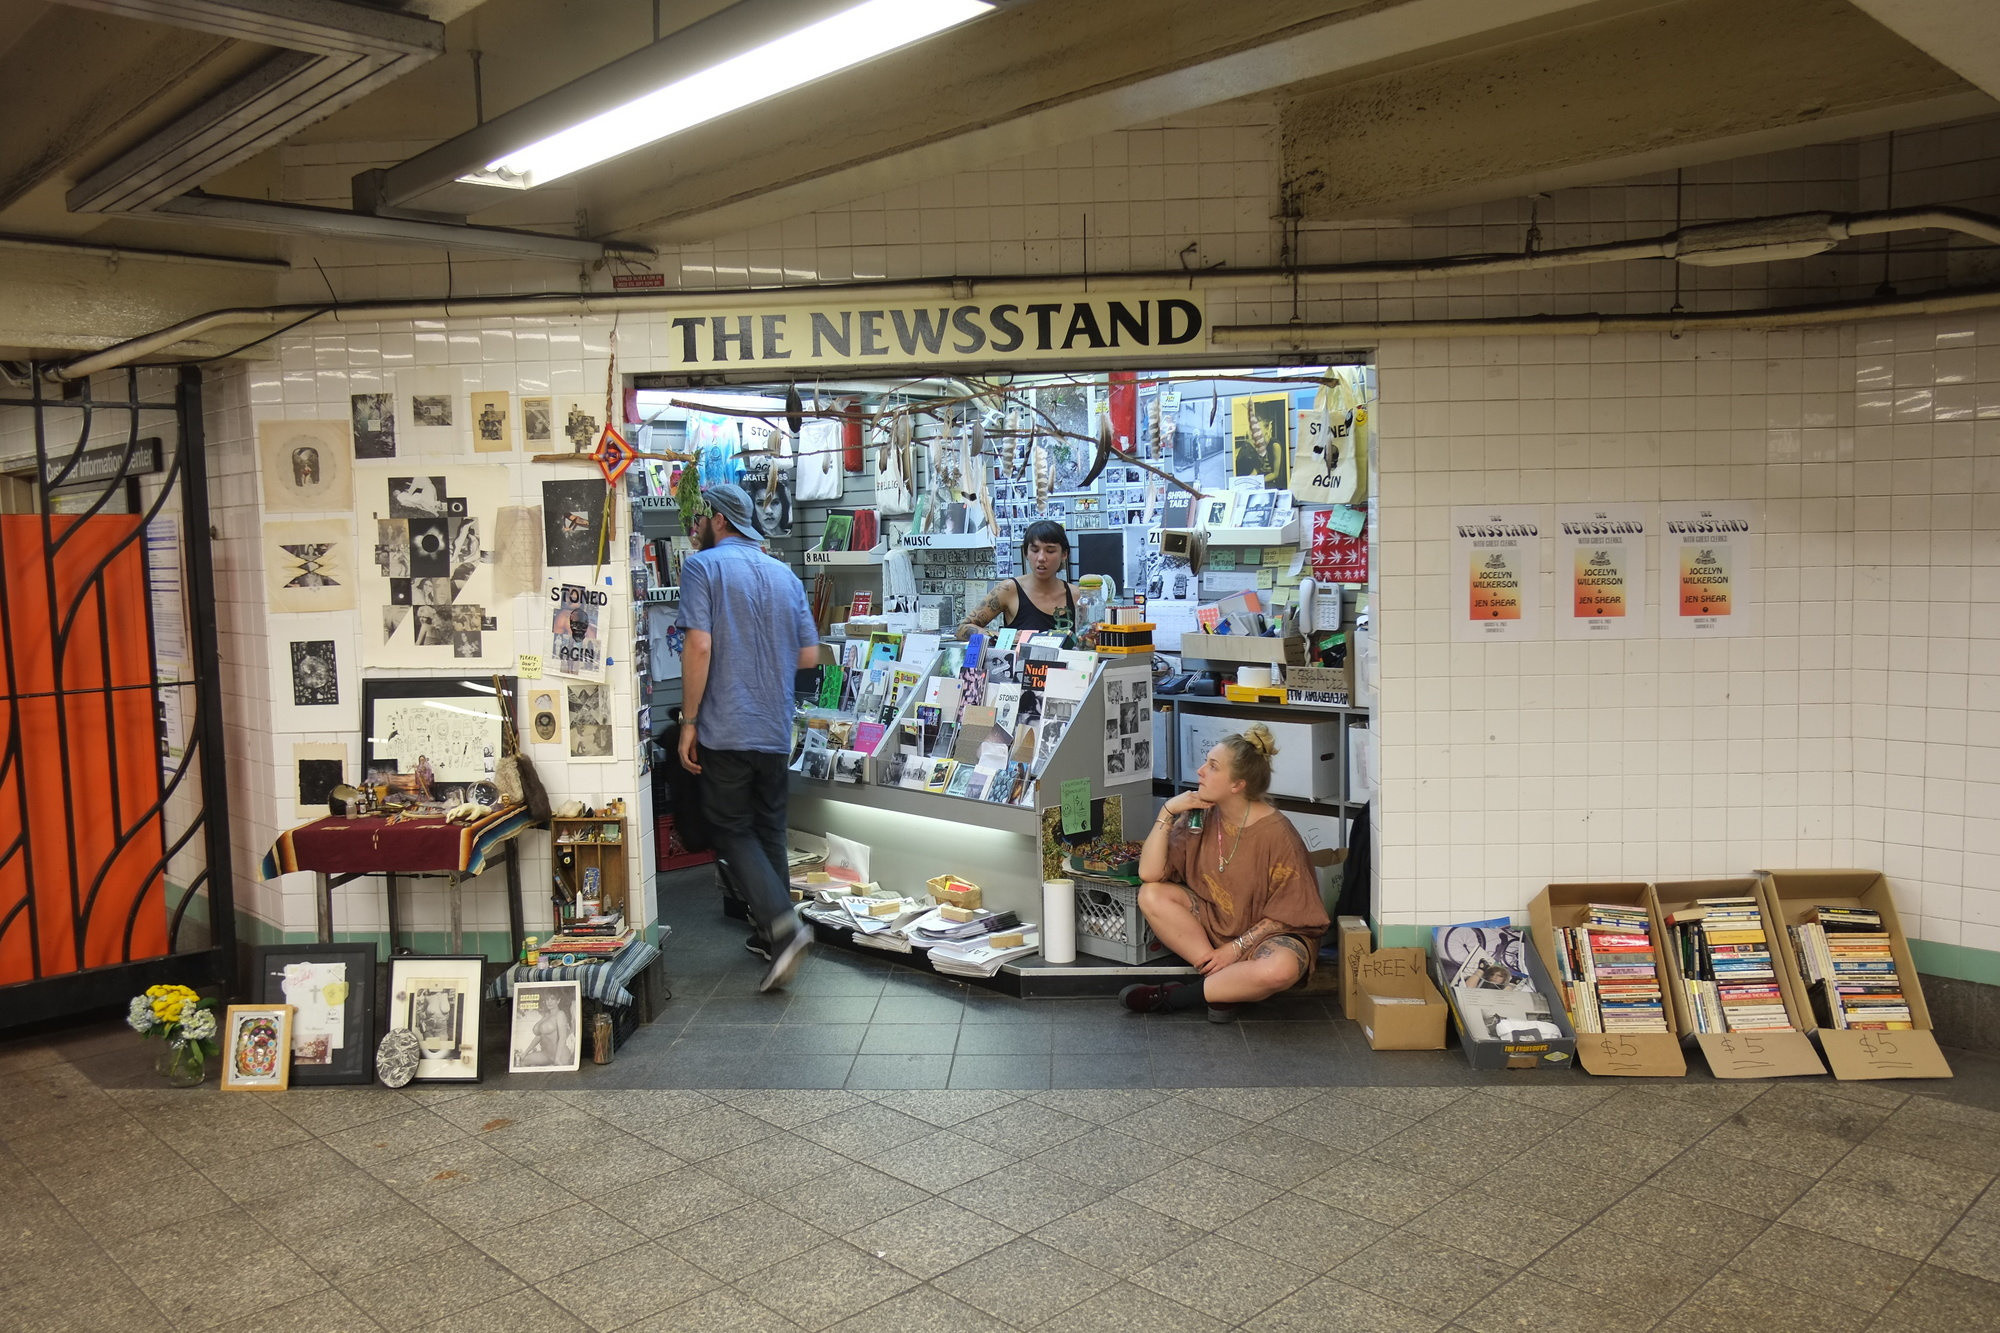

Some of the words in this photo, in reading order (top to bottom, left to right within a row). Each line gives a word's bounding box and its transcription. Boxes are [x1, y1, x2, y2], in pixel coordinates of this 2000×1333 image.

[671, 314, 792, 363] THE
[809, 298, 1202, 358] NEWSSTAND
[46, 459, 79, 482] Custer
[79, 448, 122, 477] Information
[126, 446, 154, 470] enter
[1312, 474, 1342, 489] AGIN
[1169, 499, 1189, 508] TAILS
[1456, 523, 1538, 537] NEWSSTAND
[1561, 521, 1643, 535] NEWSSTAND
[1666, 519, 1748, 533] NEWSSTAND
[903, 536, 932, 546] MUSIC
[806, 552, 811, 562] 8
[812, 552, 831, 562] BALL
[1479, 571, 1512, 579] JOCELYN
[1689, 567, 1722, 575] JOCELYN
[1683, 576, 1728, 584] WILKERSON
[550, 586, 608, 606] STONED
[1685, 595, 1698, 603] JEN
[1700, 594, 1727, 602] SHEAR
[560, 645, 594, 663] AGIN
[999, 694, 1018, 702] STONED
[1362, 958, 1407, 979] FREE
[1600, 1034, 1638, 1058] $5
[1859, 1032, 1898, 1058] $5
